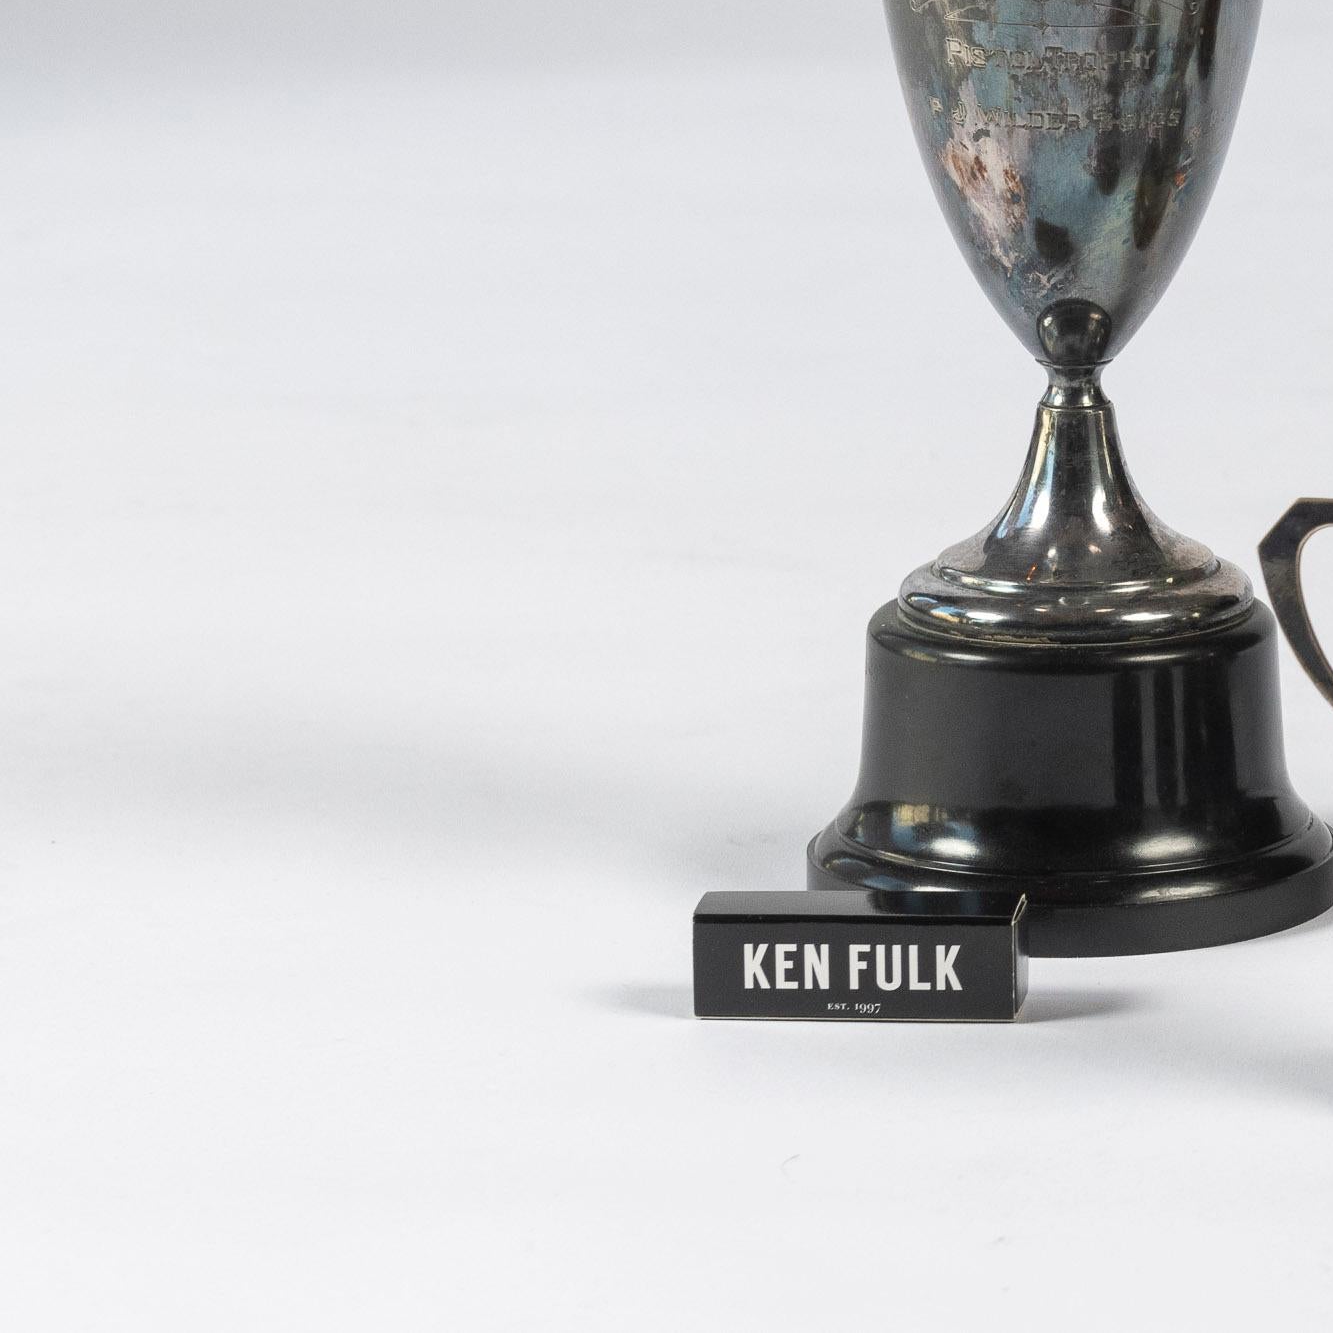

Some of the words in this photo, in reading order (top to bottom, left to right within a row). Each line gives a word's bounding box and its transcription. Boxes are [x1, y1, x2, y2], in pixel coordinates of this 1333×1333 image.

[743, 943, 830, 990] KEN
[849, 944, 963, 991] FULK
[854, 1002, 882, 1014] 1997
